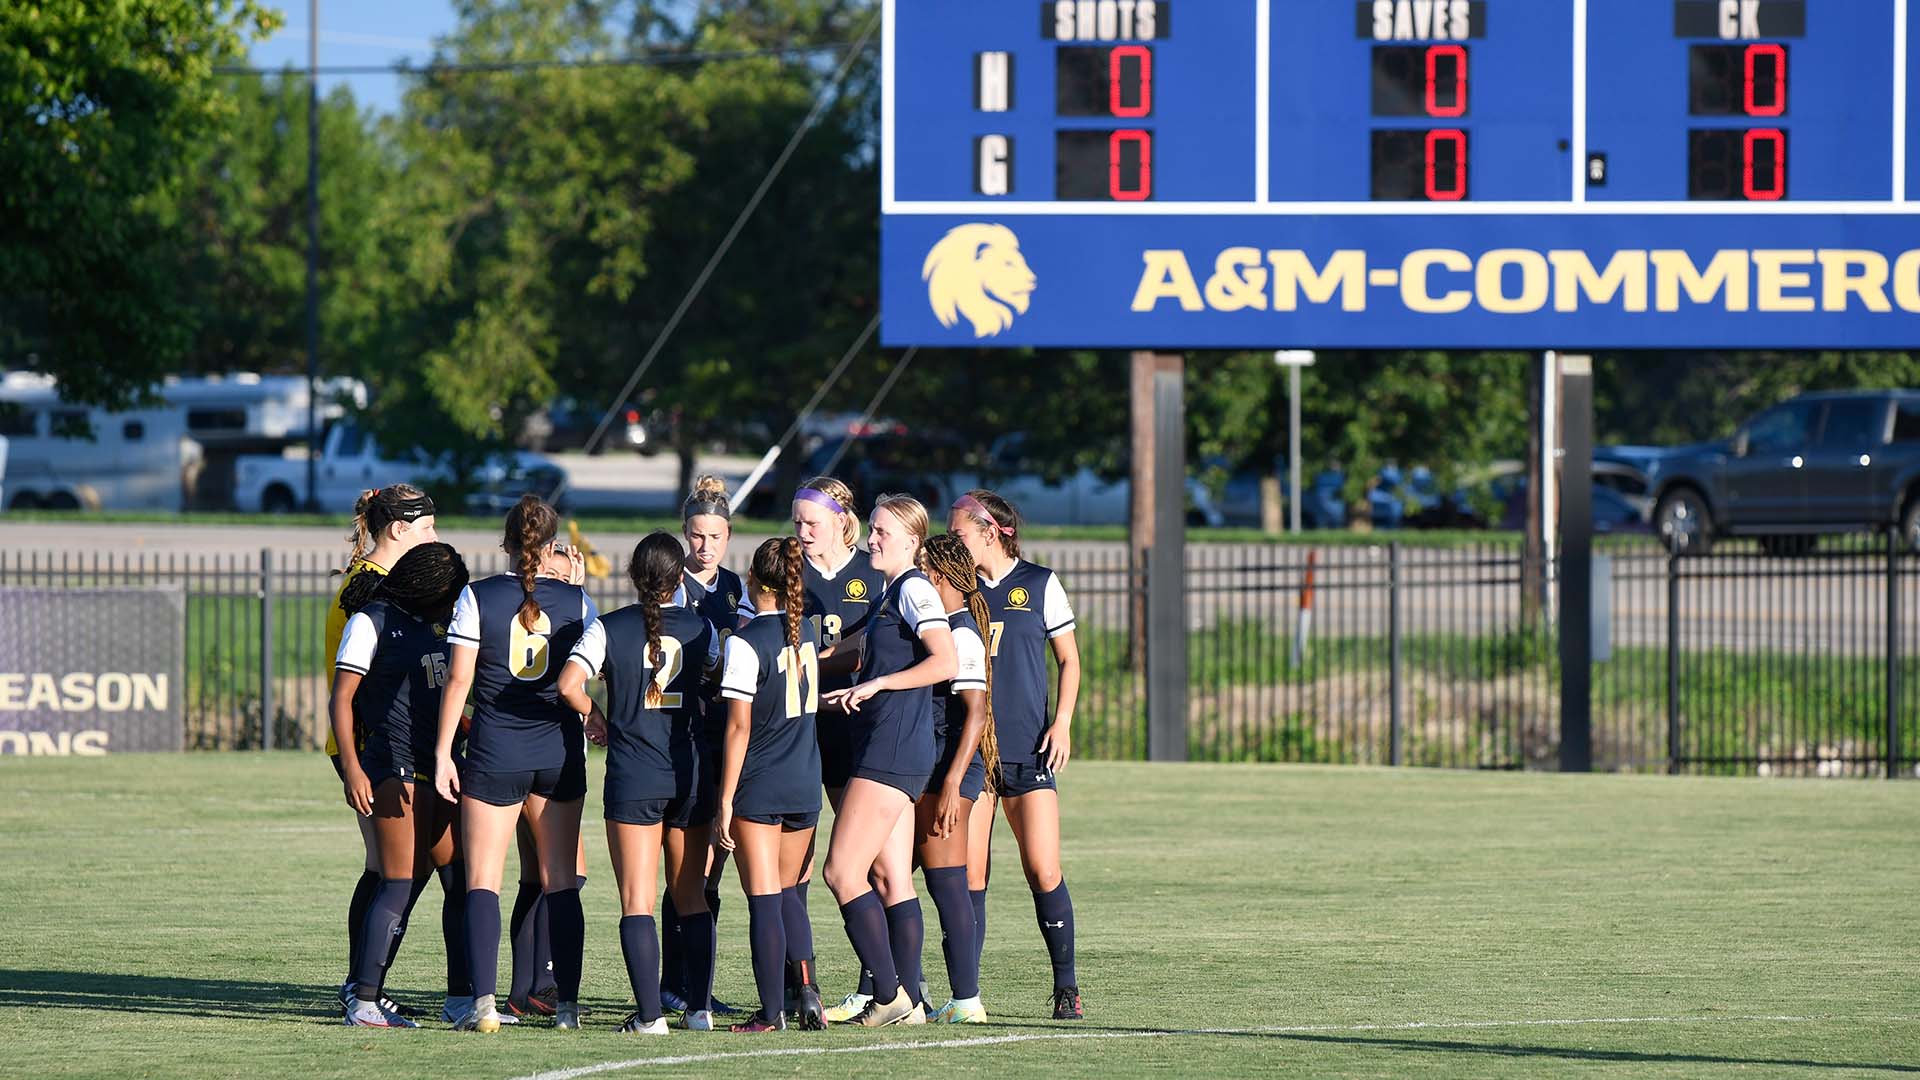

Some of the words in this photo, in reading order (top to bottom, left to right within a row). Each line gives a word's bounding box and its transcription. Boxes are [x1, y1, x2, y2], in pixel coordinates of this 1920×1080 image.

[1055, 0, 1156, 41] SHOTS
[1373, 0, 1470, 41] SAVES
[1718, 0, 1761, 40] CK
[980, 51, 1009, 112] H
[1109, 45, 1152, 117] 0
[1425, 45, 1467, 117] 0
[1743, 44, 1786, 116] 0
[980, 134, 1008, 196] G
[1109, 129, 1152, 201] 0
[1424, 129, 1467, 200] 0
[1743, 128, 1785, 200] 0
[508, 608, 551, 681] 6
[809, 613, 842, 648] 13
[0, 672, 168, 711] EASON
[420, 652, 448, 689] 15
[642, 635, 683, 709] 2
[776, 641, 819, 719] 11
